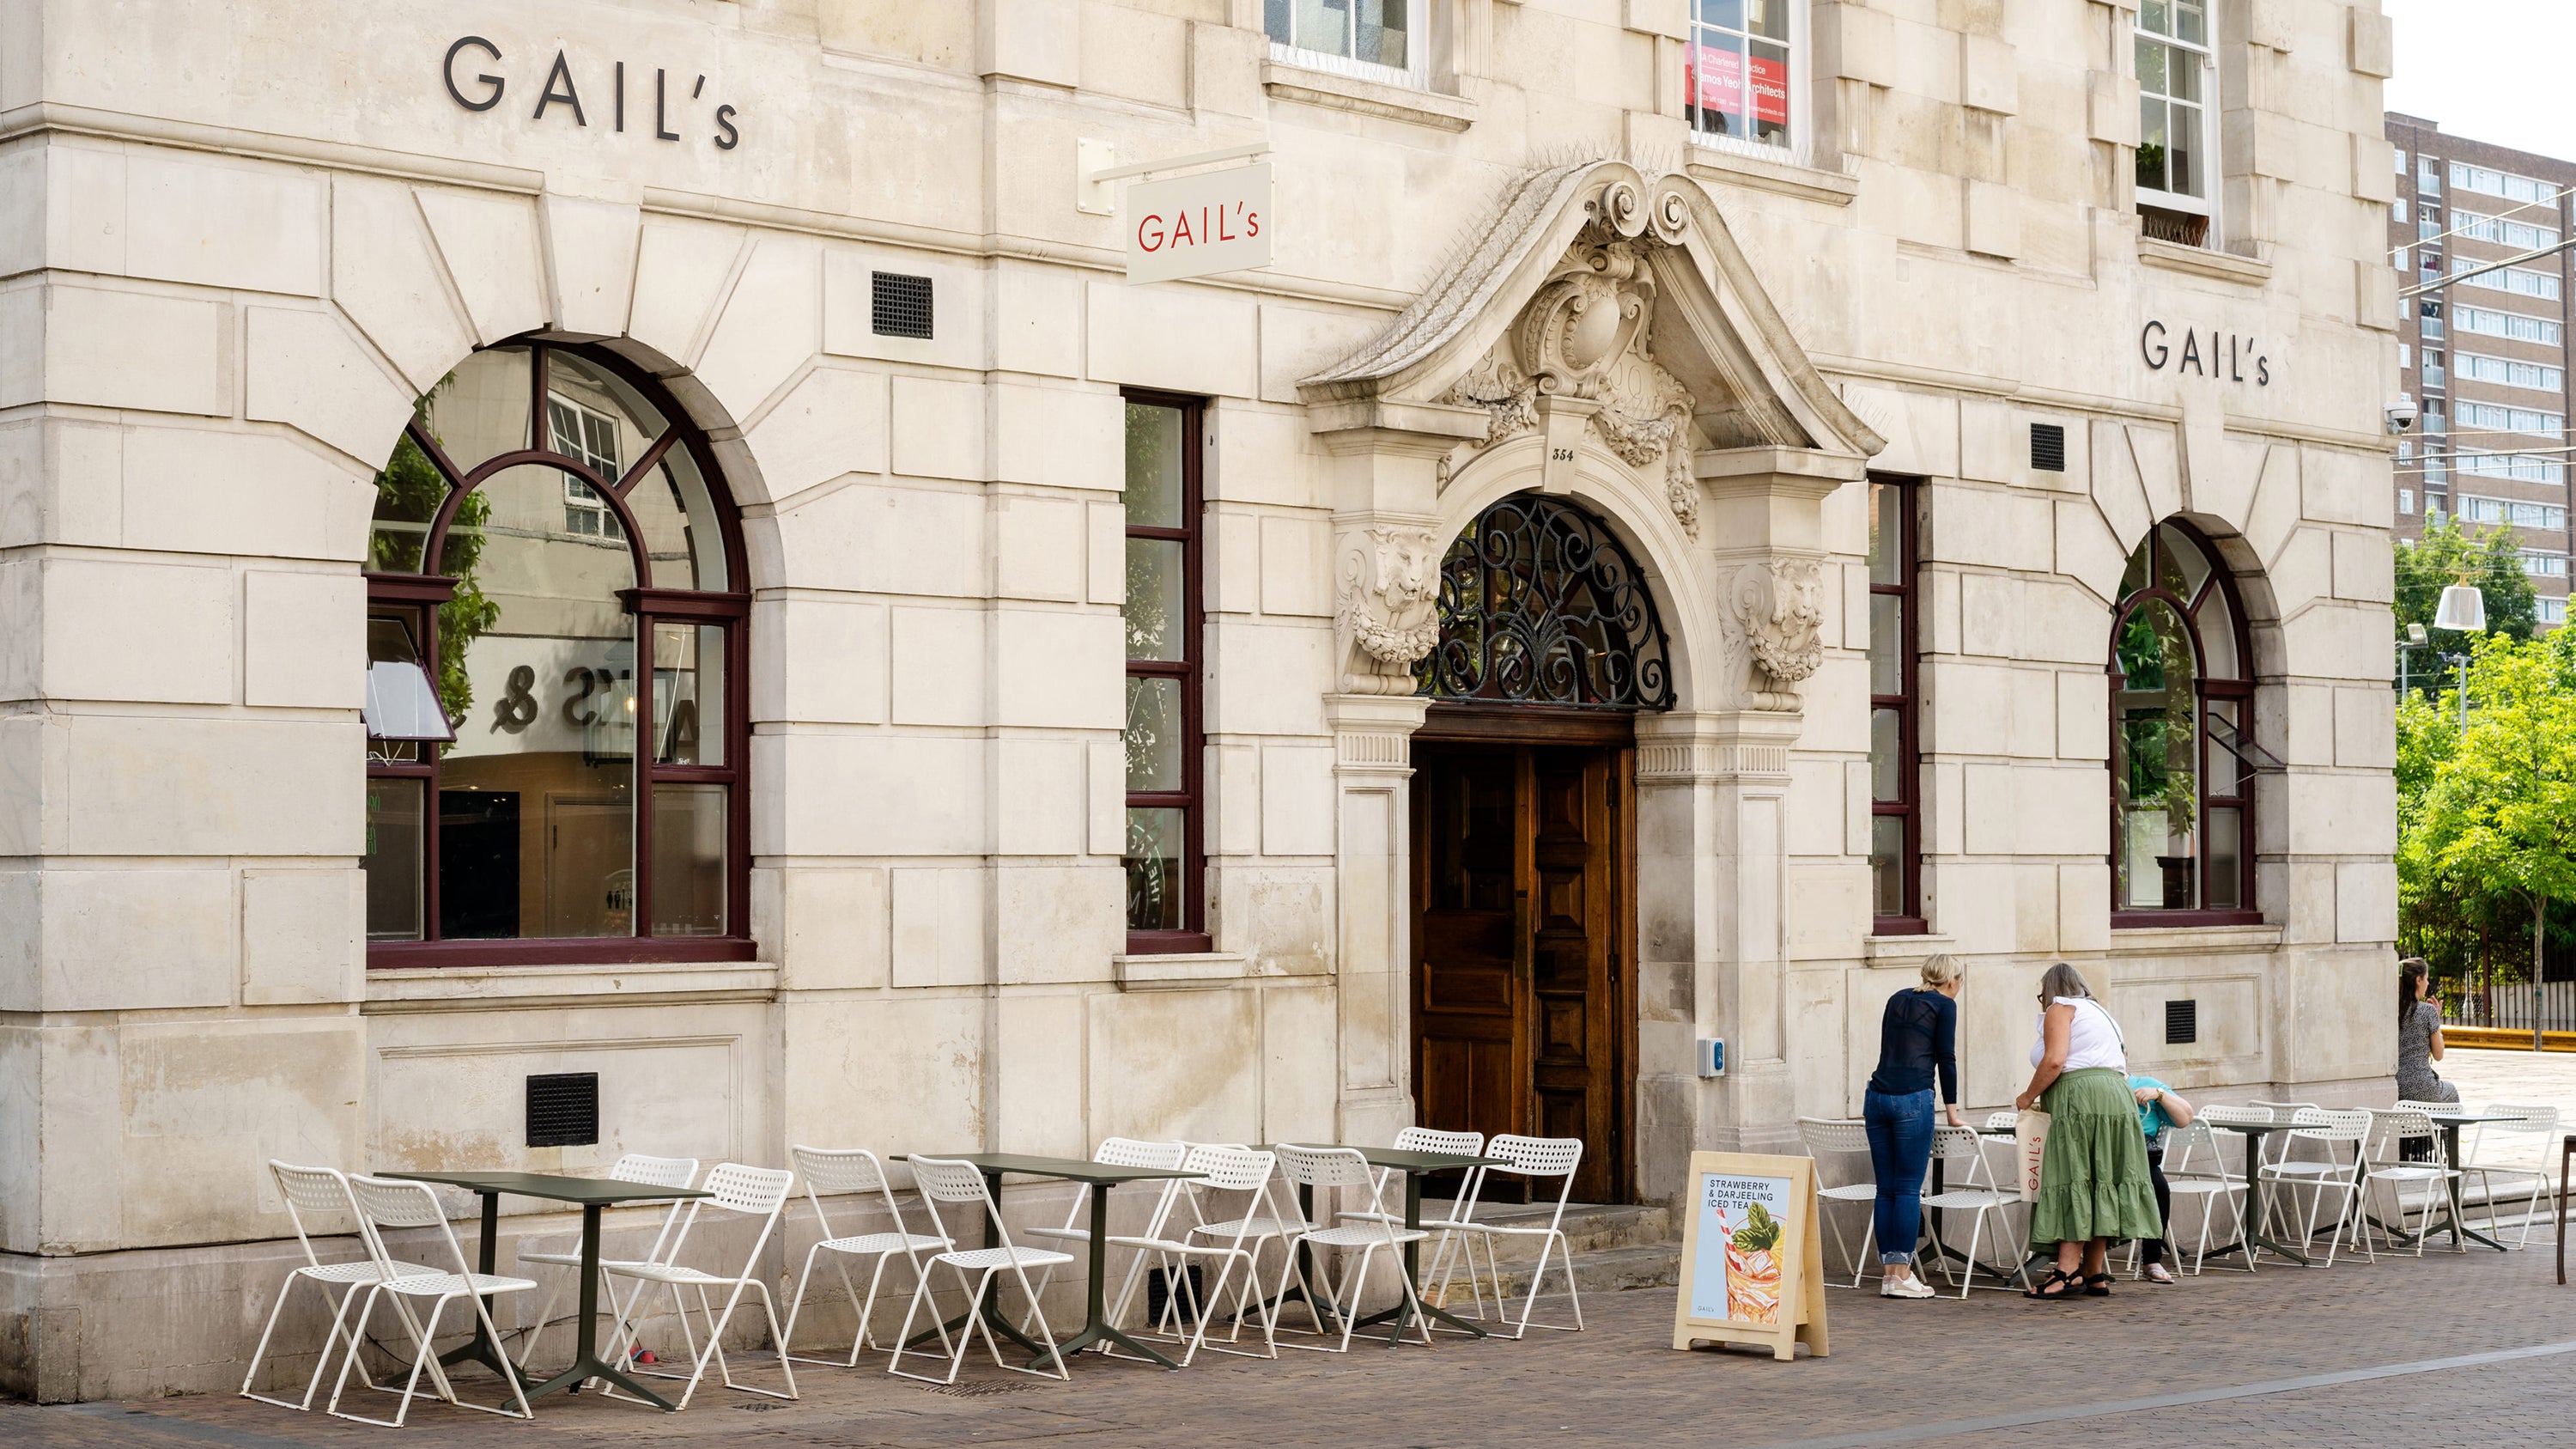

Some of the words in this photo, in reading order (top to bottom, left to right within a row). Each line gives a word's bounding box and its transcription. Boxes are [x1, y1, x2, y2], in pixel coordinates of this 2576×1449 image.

[1707, 54, 1739, 69] Chartered
[443, 35, 739, 150] GAIL's
[1138, 201, 1260, 253] GAIL's
[2142, 320, 2269, 387] GAIL's
[1552, 448, 1574, 462] 354
[2028, 1136, 2041, 1191] GAIL's
[1710, 1179, 1770, 1190] STRAWBERRY
[1717, 1190, 1773, 1201] DARJEELING
[1708, 1199, 1729, 1209] ICED
[1732, 1201, 1749, 1209] TEA
